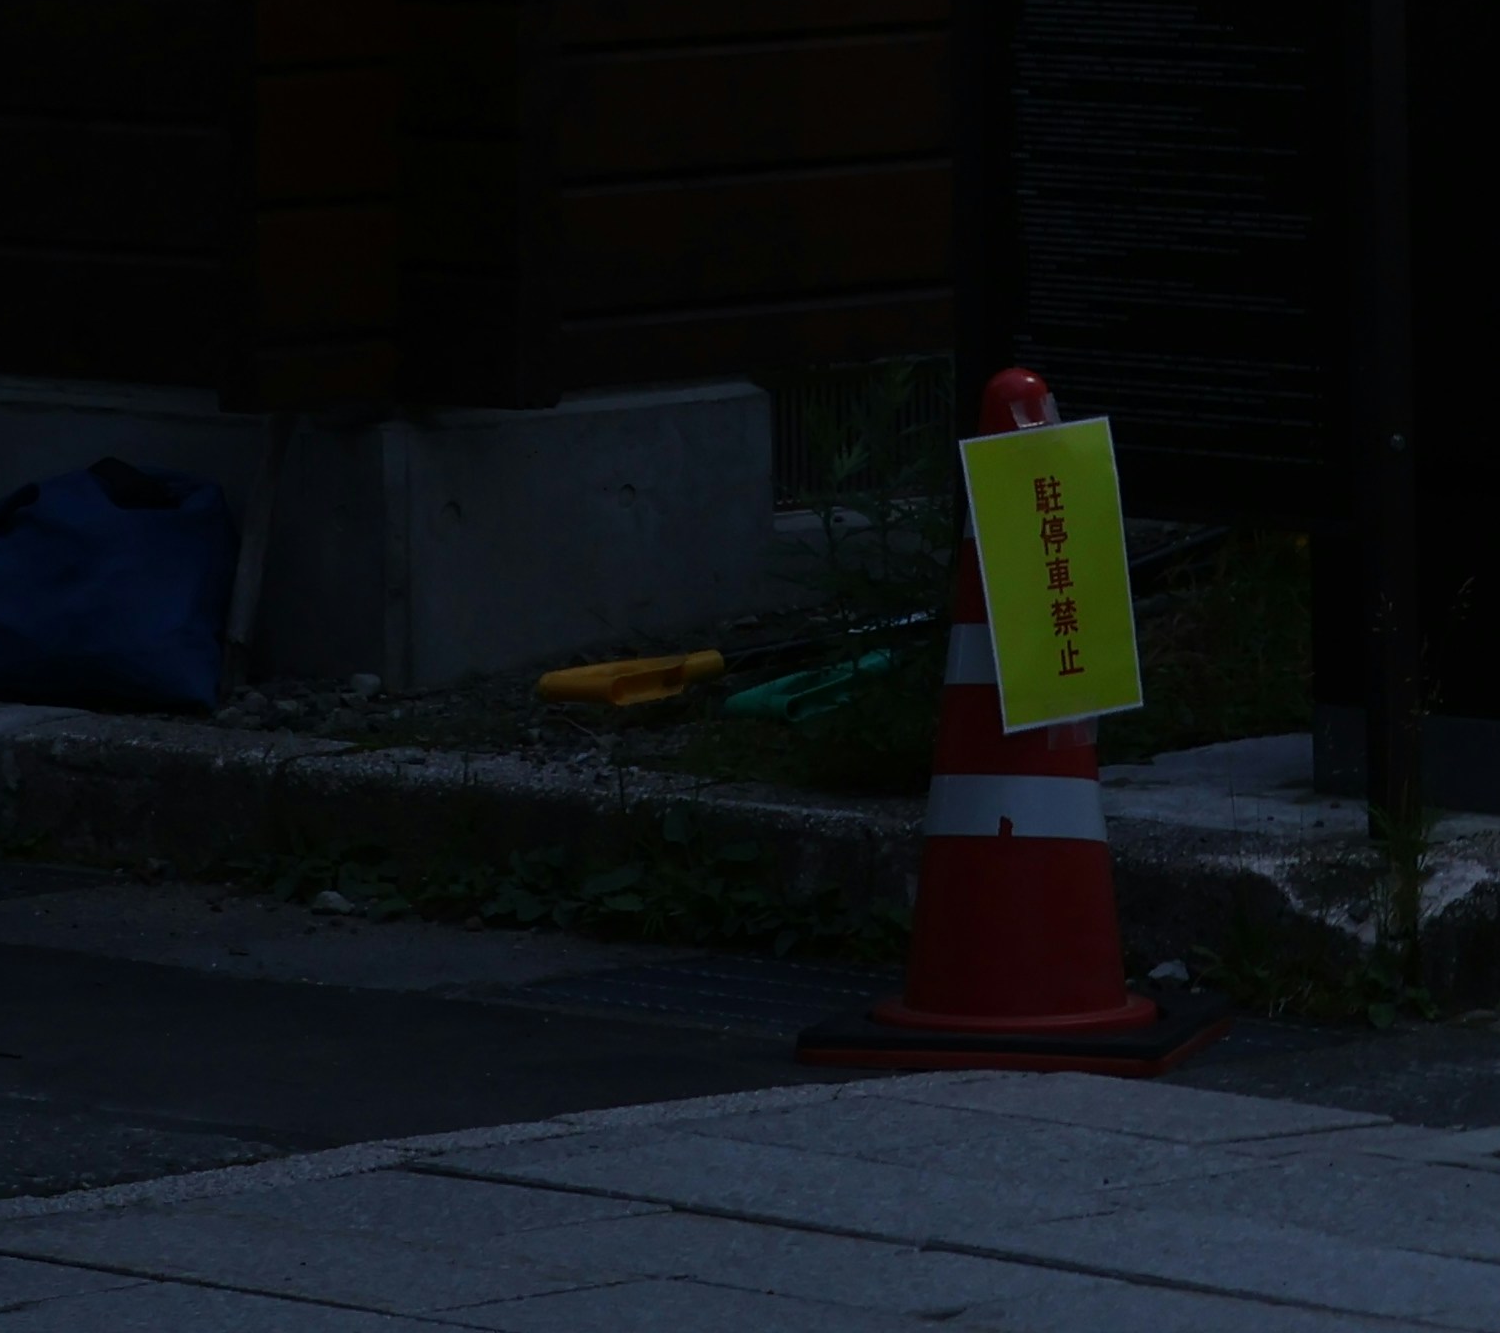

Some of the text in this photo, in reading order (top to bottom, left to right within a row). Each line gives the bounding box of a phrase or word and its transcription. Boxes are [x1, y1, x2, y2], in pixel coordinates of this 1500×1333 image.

[1034, 476, 1085, 677] 駐停車禁止
